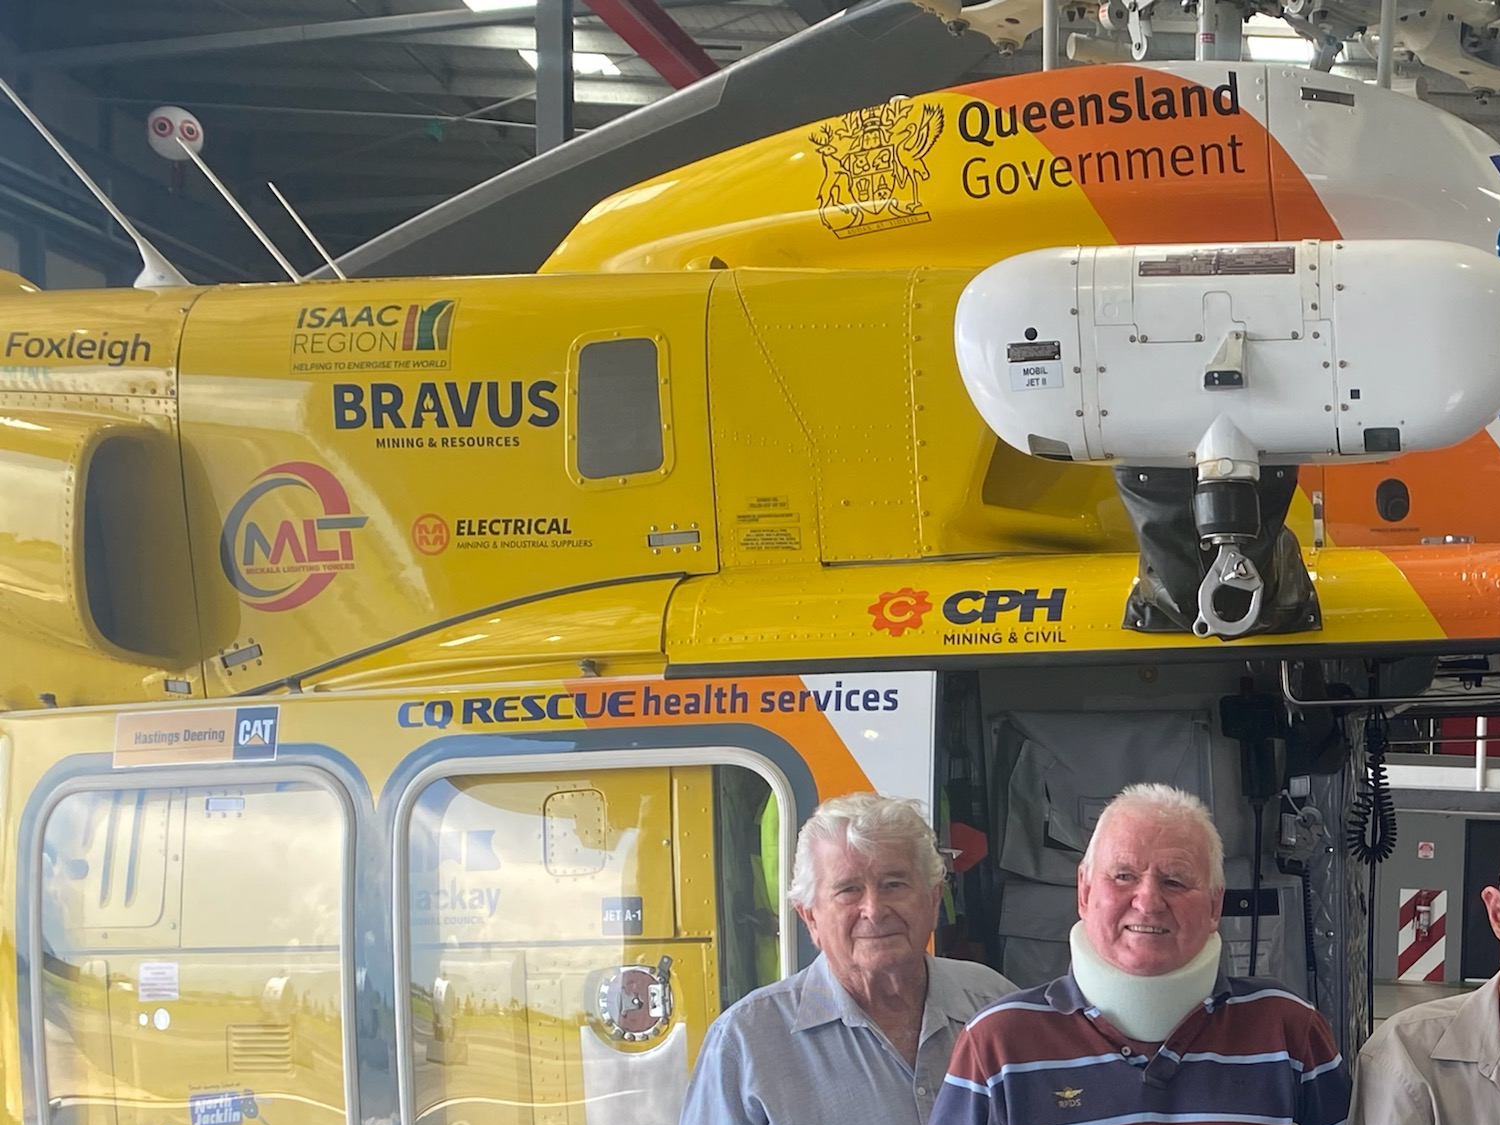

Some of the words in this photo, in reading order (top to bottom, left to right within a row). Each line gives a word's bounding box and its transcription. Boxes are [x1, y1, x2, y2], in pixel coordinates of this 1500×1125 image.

[958, 70, 1240, 147] Queensland
[962, 134, 1246, 200] Government
[297, 305, 402, 329] ISAAC
[5, 331, 151, 367] Foxleigh
[293, 331, 398, 354] REGION
[293, 361, 333, 371] HELPING
[334, 361, 346, 370] TO
[347, 360, 392, 370] ENERGISE
[393, 360, 411, 369] THE
[412, 359, 447, 369] WORLD
[1023, 367, 1048, 376] MOBIL
[1026, 378, 1040, 387] JET
[333, 380, 560, 430] BRAVUS
[376, 437, 424, 449] MINING
[428, 437, 437, 448] &
[441, 436, 520, 447] RESOURCES
[456, 518, 572, 536] ELECTRICAL
[457, 541, 490, 549] MINING
[501, 540, 549, 549] INDUSTRIAL
[551, 539, 593, 548] SUPPLIERS
[942, 588, 1067, 624] CPH
[943, 633, 1002, 645] MINING
[1008, 633, 1017, 643] &
[1024, 631, 1066, 643] CIVIL
[397, 700, 454, 729] CQ
[461, 692, 636, 725] RESCUE
[643, 685, 749, 715] health
[759, 681, 898, 714] services
[134, 731, 180, 745] Hastings
[183, 728, 225, 742] Deering
[239, 719, 274, 745] CAT
[415, 876, 501, 918] ackay
[603, 910, 621, 921] JET
[625, 910, 641, 921] A-1
